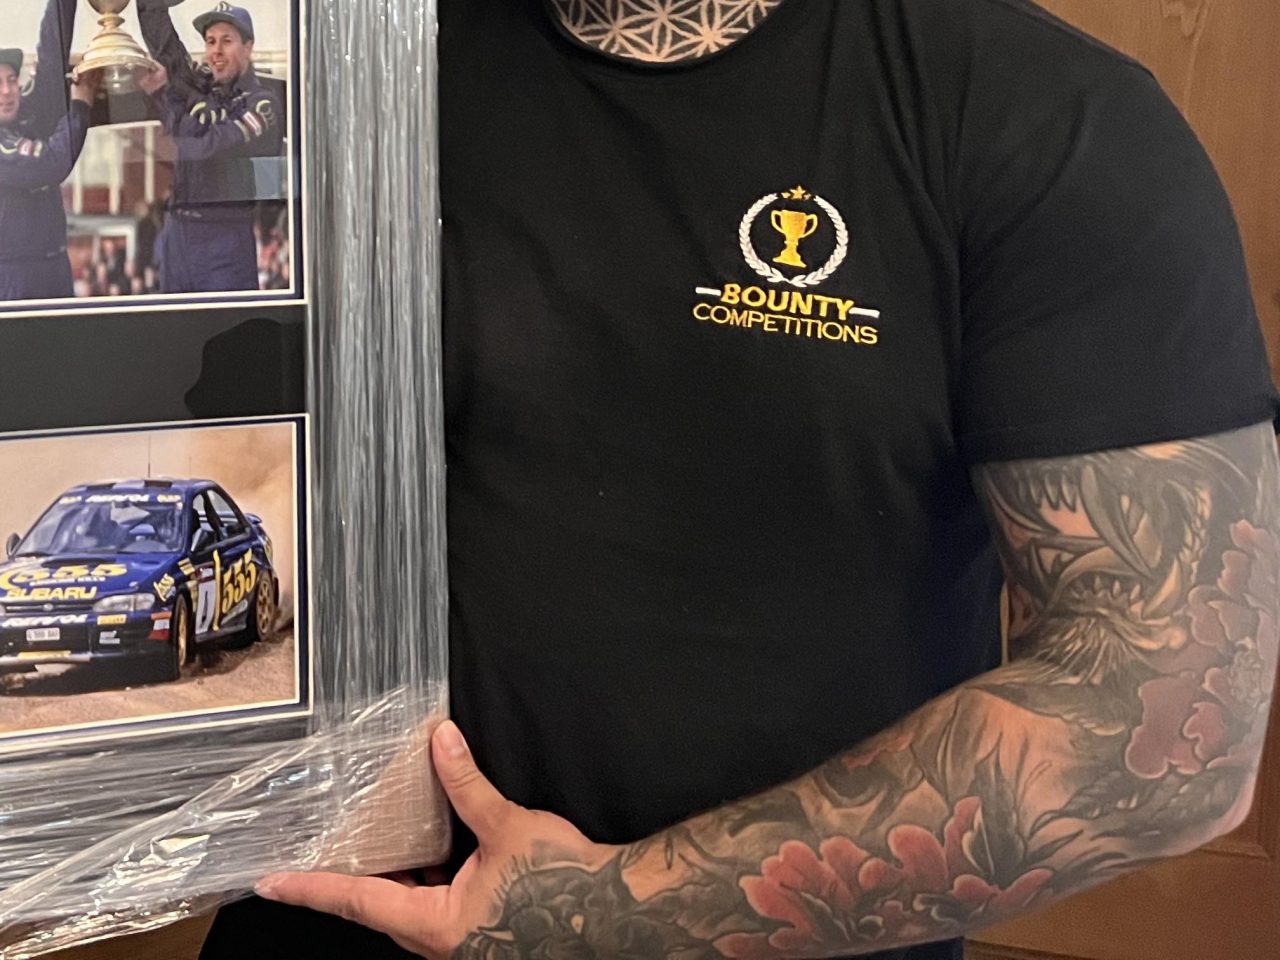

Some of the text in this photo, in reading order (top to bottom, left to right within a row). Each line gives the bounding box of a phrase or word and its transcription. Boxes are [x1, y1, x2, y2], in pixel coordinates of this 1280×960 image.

[721, 284, 855, 320] BOUNTY
[693, 304, 878, 344] COMPETITIONS
[222, 548, 257, 613] 555
